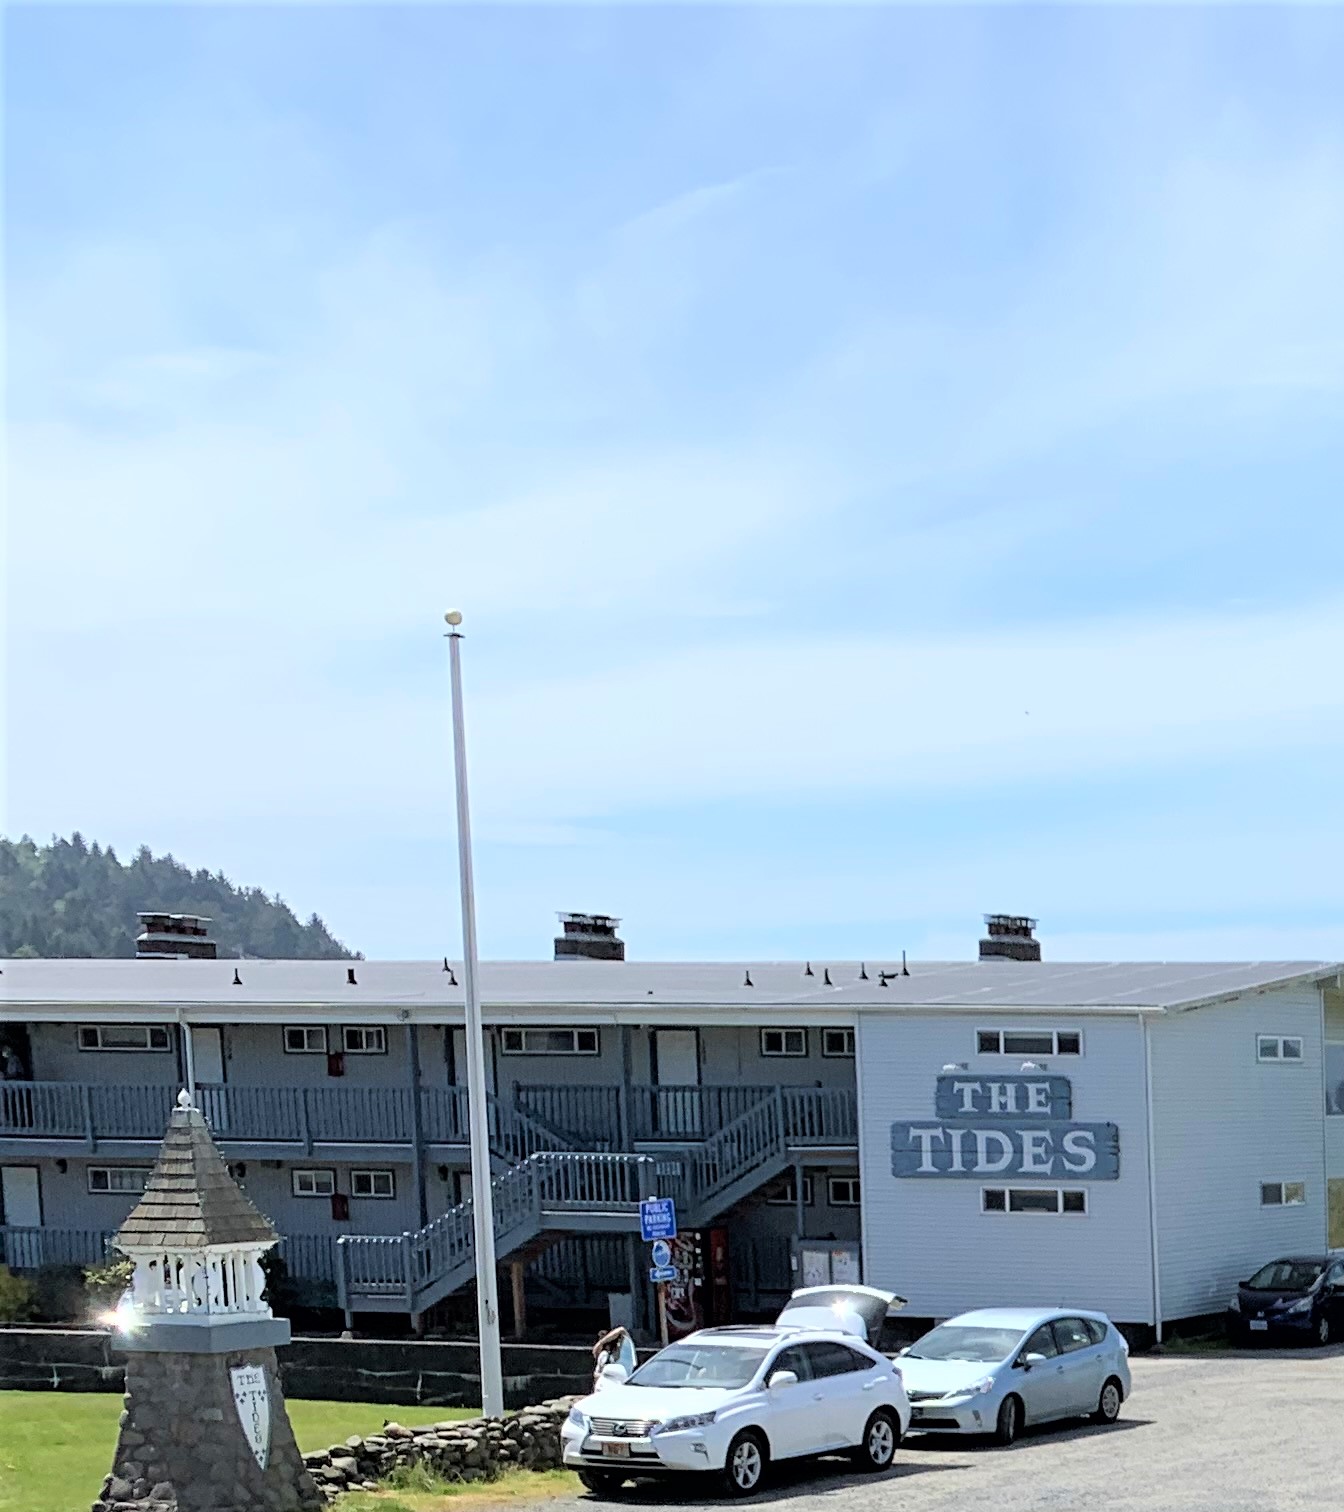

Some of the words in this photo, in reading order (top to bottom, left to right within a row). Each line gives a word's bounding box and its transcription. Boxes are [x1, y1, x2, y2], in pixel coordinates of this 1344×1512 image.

[953, 1081, 1050, 1114] THE
[908, 1126, 1097, 1175] TIDES
[644, 1213, 672, 1225] PARKING
[645, 1202, 669, 1214] PUBLIC
